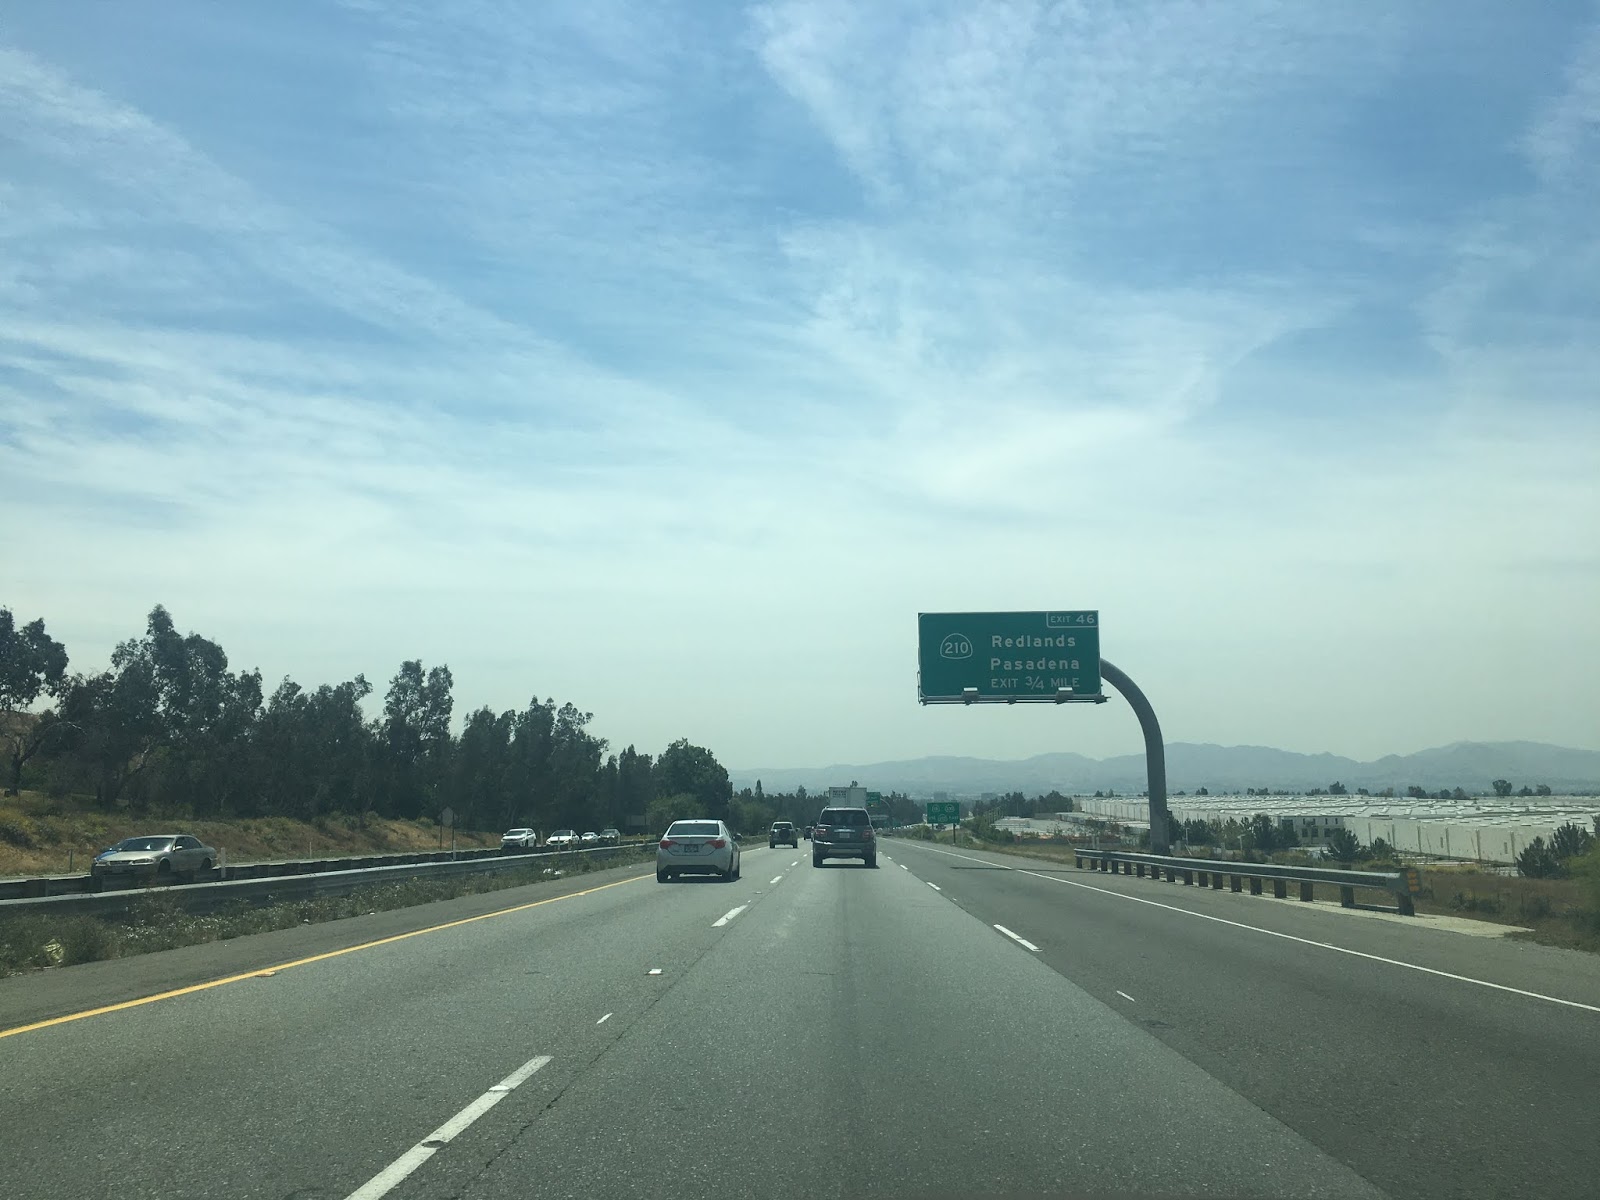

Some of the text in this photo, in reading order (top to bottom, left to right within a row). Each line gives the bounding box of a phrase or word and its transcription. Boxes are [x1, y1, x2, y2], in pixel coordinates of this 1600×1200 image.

[1051, 614, 1095, 624] EXIT 46
[991, 635, 1076, 648] Redlands
[944, 642, 969, 654] 210
[990, 657, 1080, 671] Pasadena
[991, 678, 1019, 688] EXIT
[1050, 677, 1080, 688] MILE
